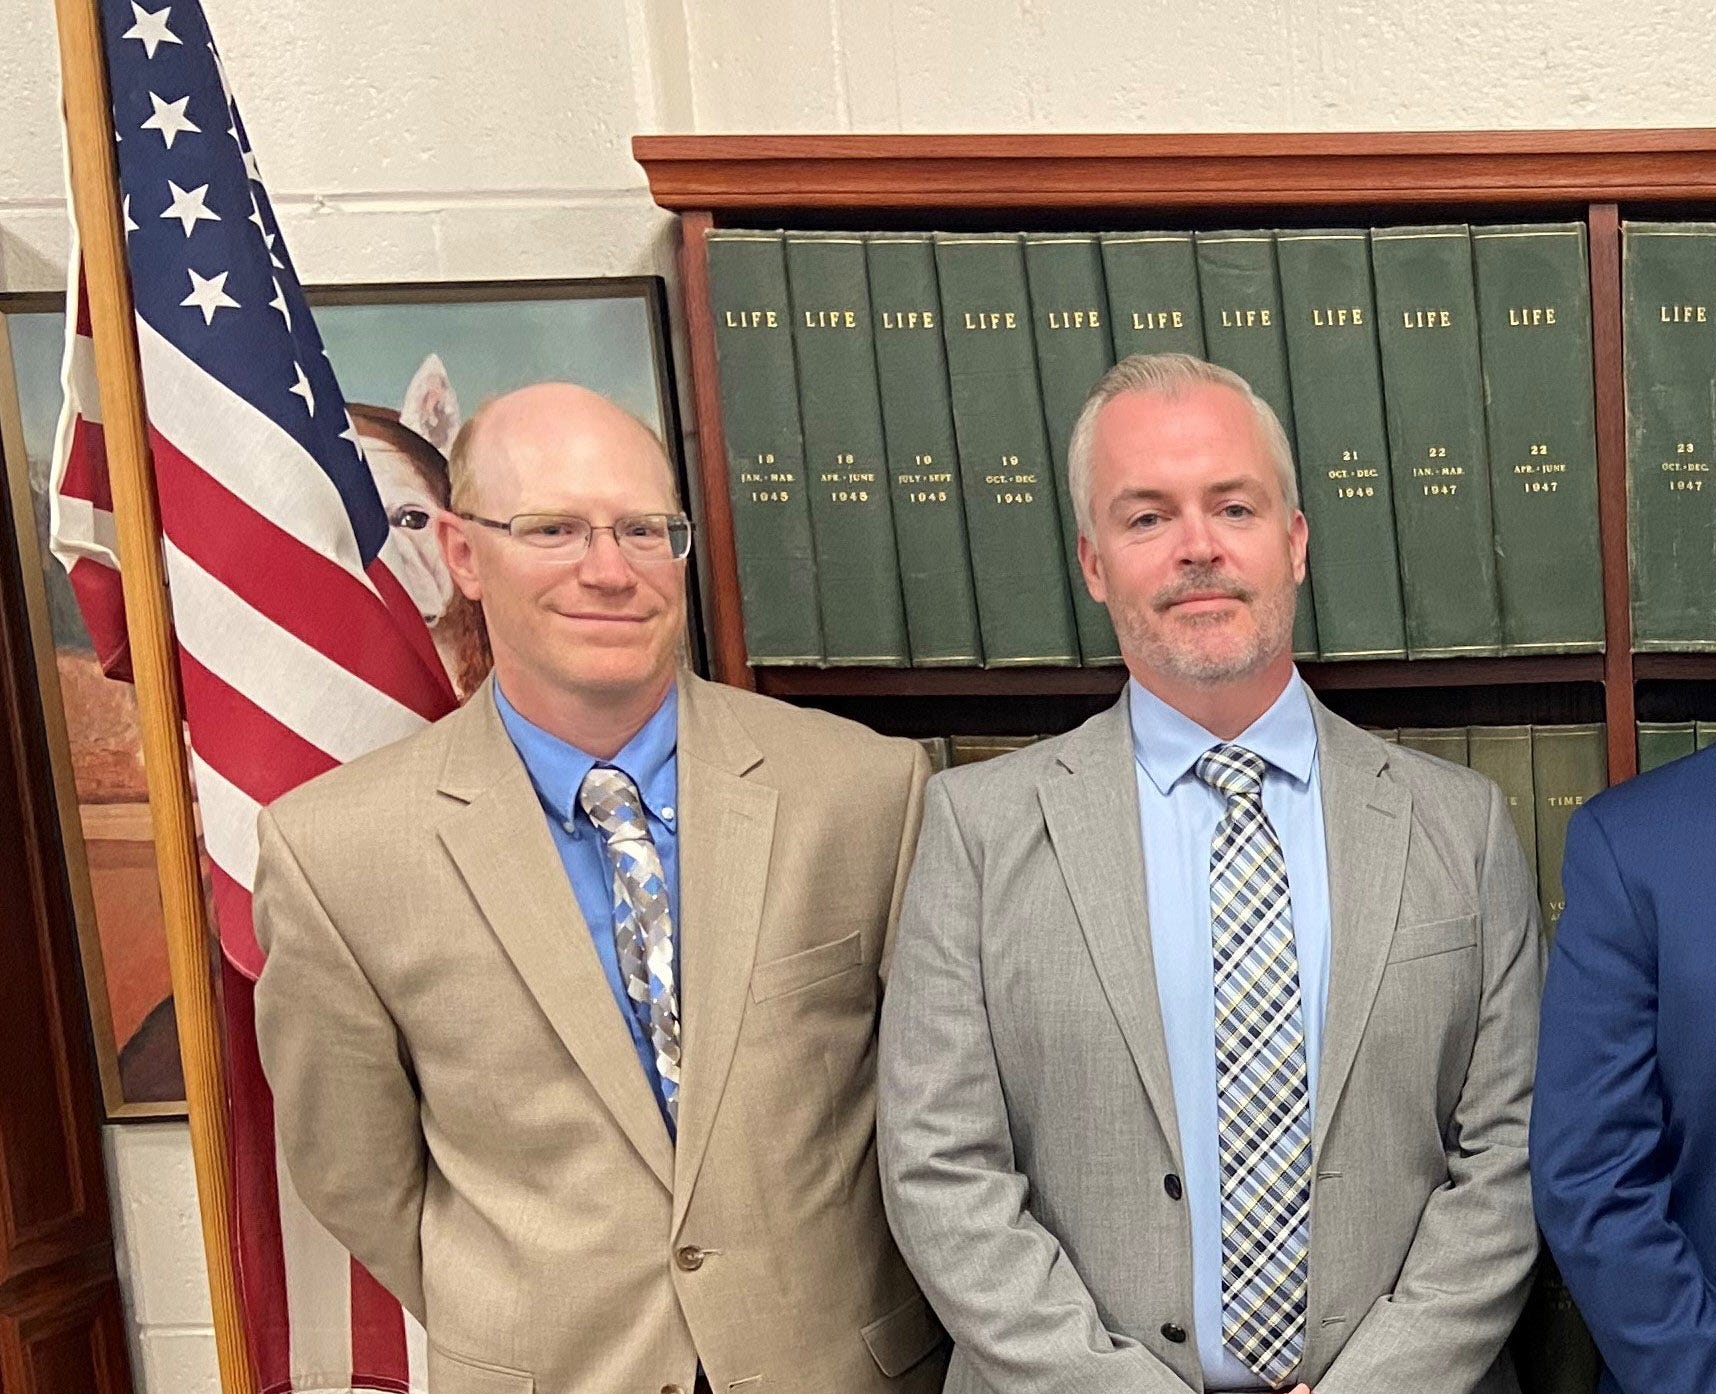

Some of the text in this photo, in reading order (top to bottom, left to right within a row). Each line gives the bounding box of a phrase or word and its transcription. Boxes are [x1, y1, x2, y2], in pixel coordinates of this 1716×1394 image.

[726, 311, 778, 328] LIFE
[805, 312, 856, 328] LIFE
[883, 312, 934, 329] LIFE
[965, 313, 1016, 330] LIFE
[1049, 311, 1100, 328] LIFE
[1132, 311, 1184, 330] LIFE
[1222, 310, 1272, 327] LIFE
[1313, 308, 1363, 326] LIFE
[1404, 310, 1451, 328] LIFE
[1508, 308, 1557, 325] LIFE
[1661, 306, 1706, 322] LIFE
[1342, 450, 1359, 462] 21
[1429, 447, 1446, 458] 22
[1677, 443, 1695, 454] 23
[1423, 484, 1458, 497] 1947
[1523, 481, 1559, 494] 1947
[1669, 480, 1703, 492] 1947
[1548, 796, 1584, 807] TIME
